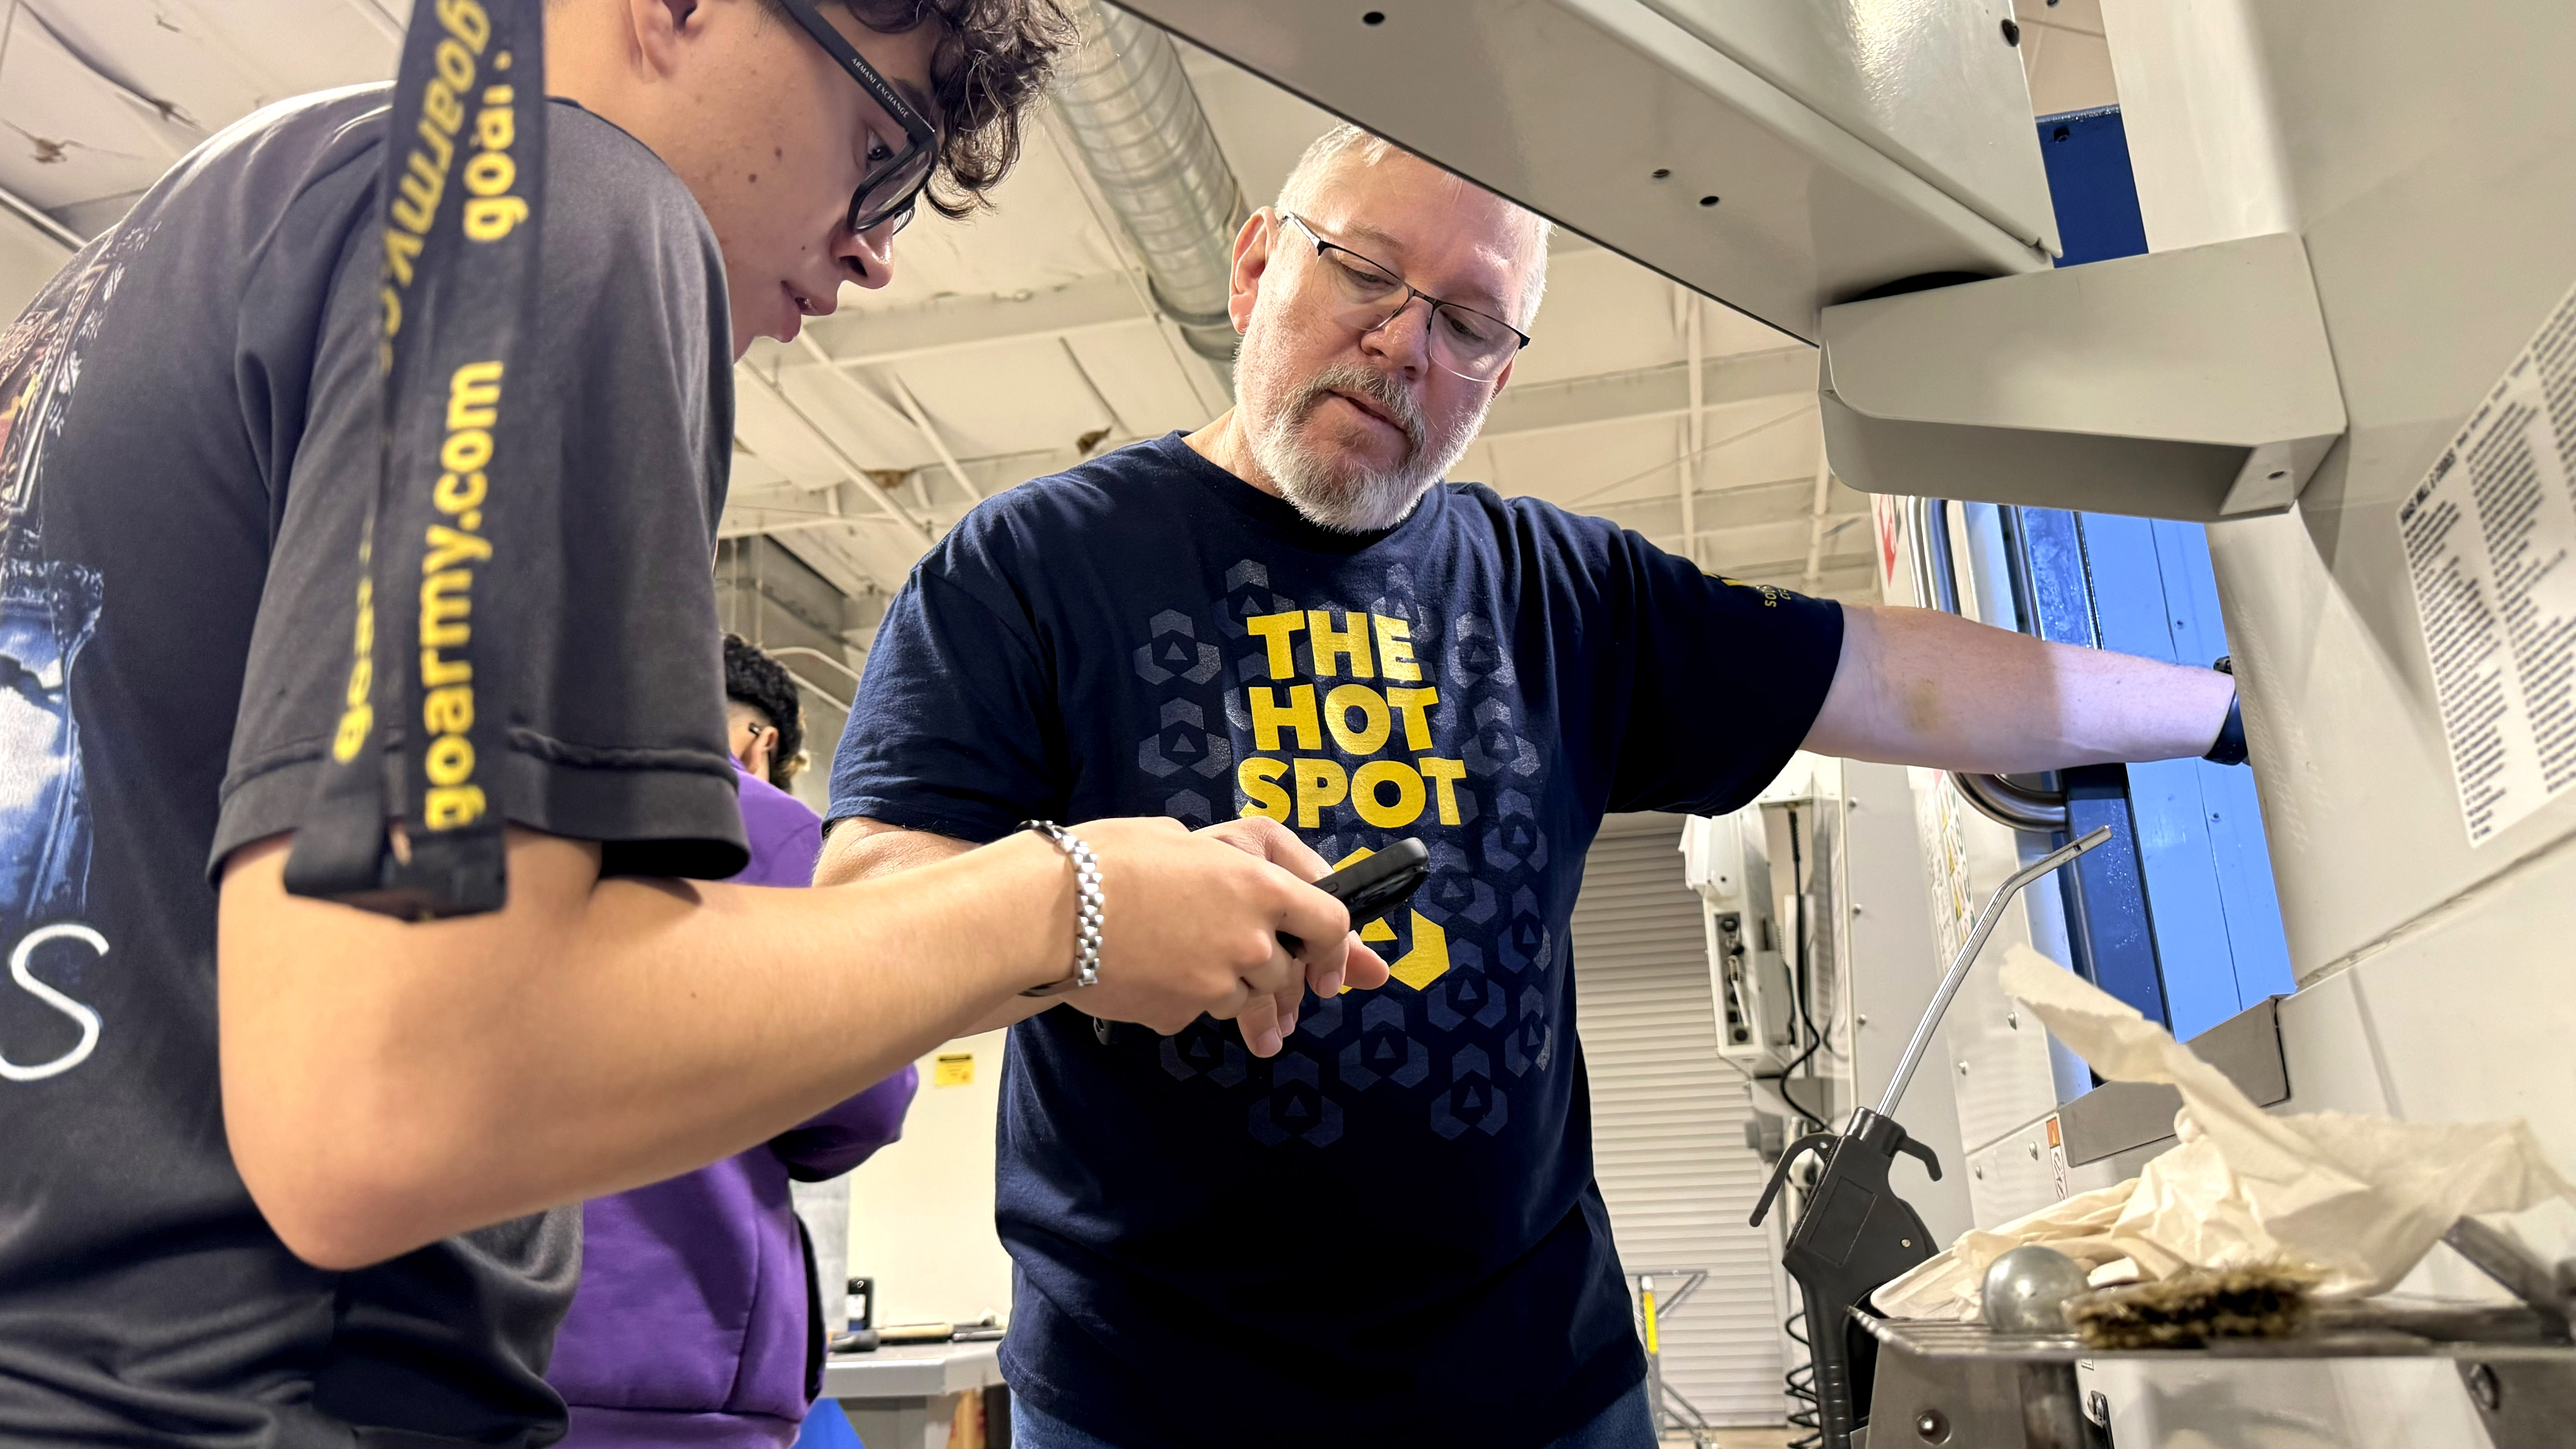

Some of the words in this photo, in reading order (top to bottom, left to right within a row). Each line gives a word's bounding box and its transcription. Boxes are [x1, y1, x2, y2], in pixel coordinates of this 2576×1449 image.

[852, 58, 877, 83] ARMANI
[877, 83, 909, 118] EXCHANGE
[420, 361, 504, 832] goarmy.com
[1247, 610, 1422, 681] THE
[1248, 684, 1439, 755] HOT
[1237, 757, 1467, 828] SPOT
